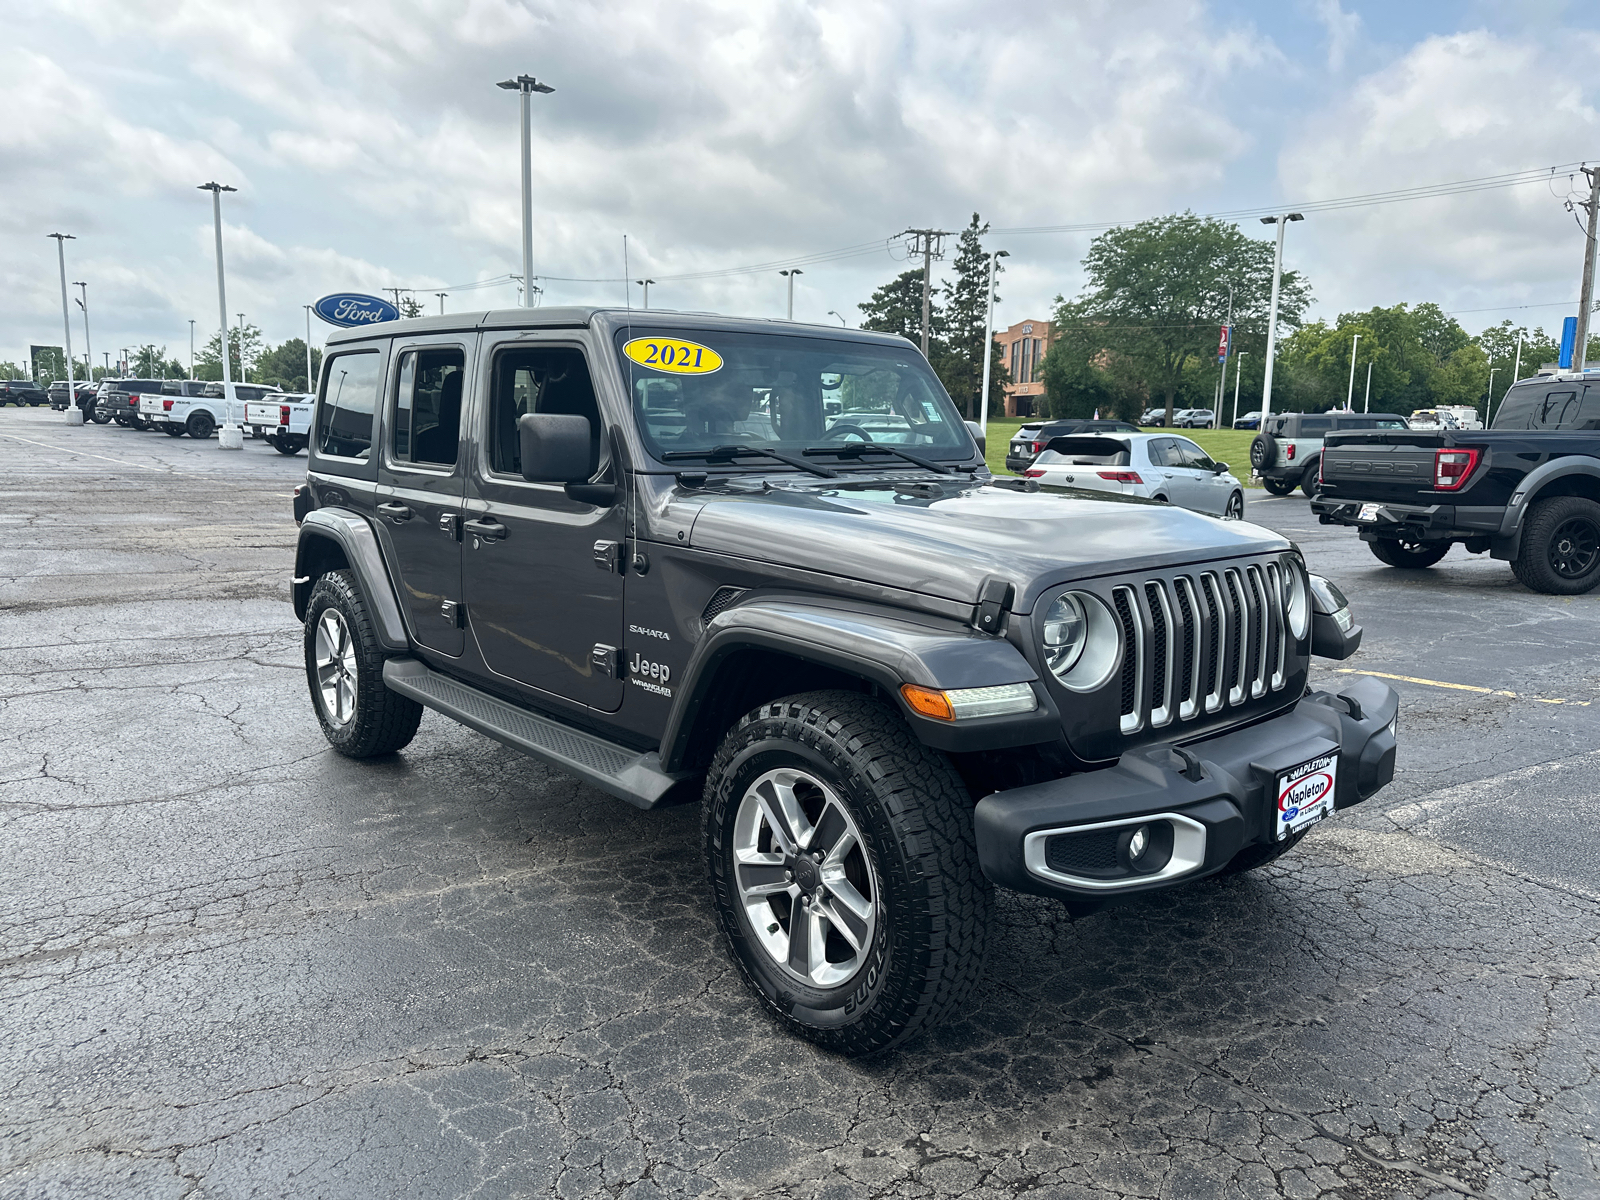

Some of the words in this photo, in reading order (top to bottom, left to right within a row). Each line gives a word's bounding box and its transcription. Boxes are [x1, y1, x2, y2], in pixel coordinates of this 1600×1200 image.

[334, 299, 383, 322] Ford
[644, 344, 703, 368] 2021
[1332, 461, 1419, 475] FORD
[629, 624, 671, 641] SAHARA
[629, 652, 671, 684] Jeep
[631, 677, 672, 694] WRANGLER
[1287, 781, 1325, 807] Napleton
